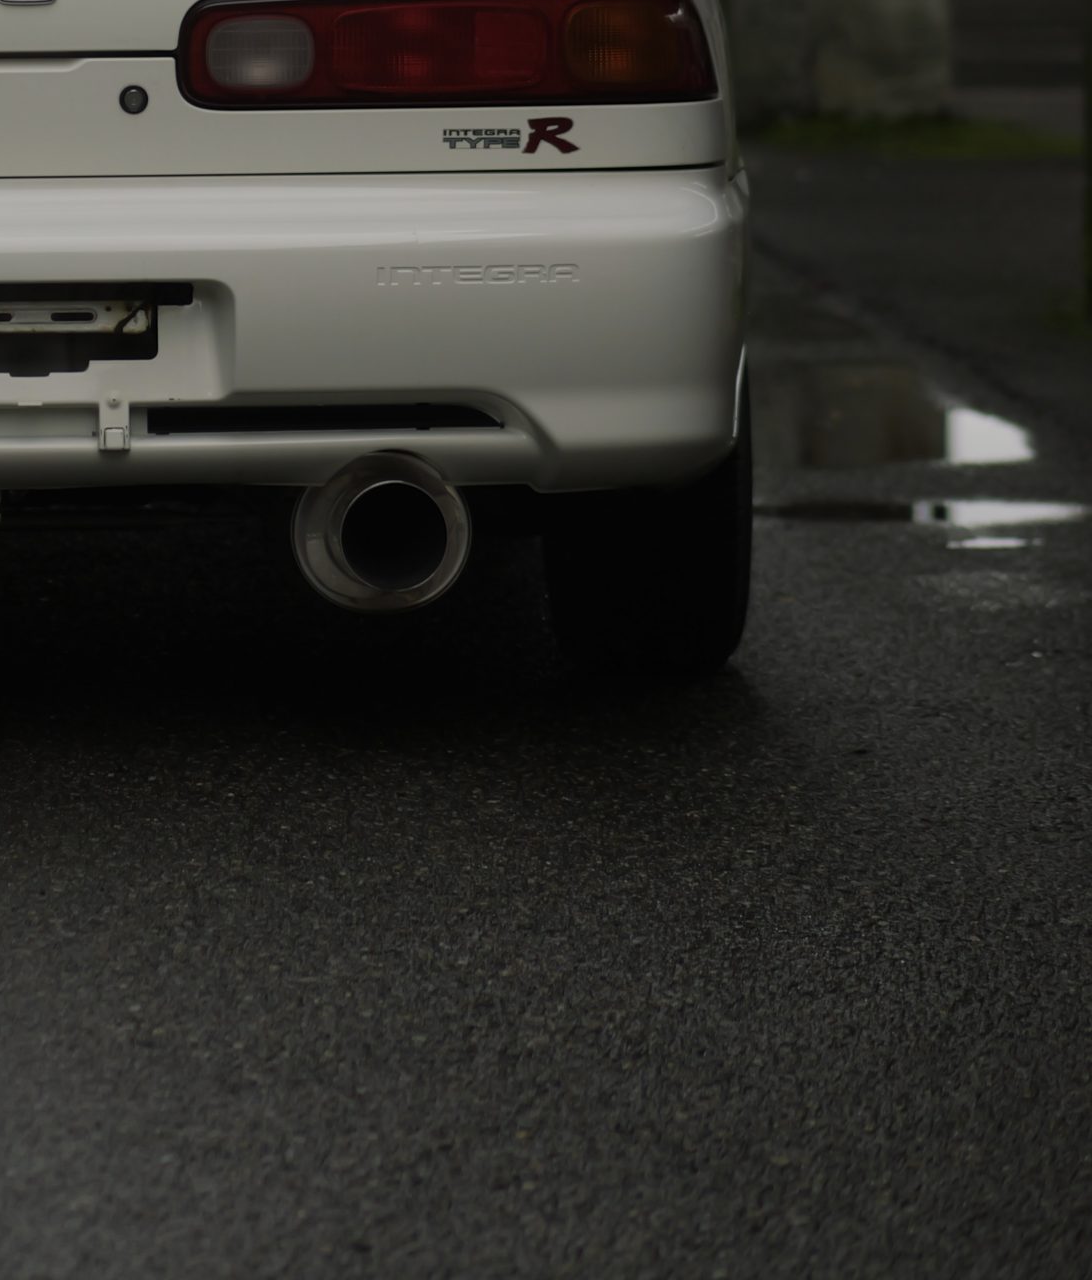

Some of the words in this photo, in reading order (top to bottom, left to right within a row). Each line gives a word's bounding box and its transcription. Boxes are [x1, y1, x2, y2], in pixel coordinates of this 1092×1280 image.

[443, 128, 521, 136] INTEGRA
[443, 137, 521, 149] TYPE
[522, 117, 580, 154] R
[377, 264, 580, 285] INTEGRA
